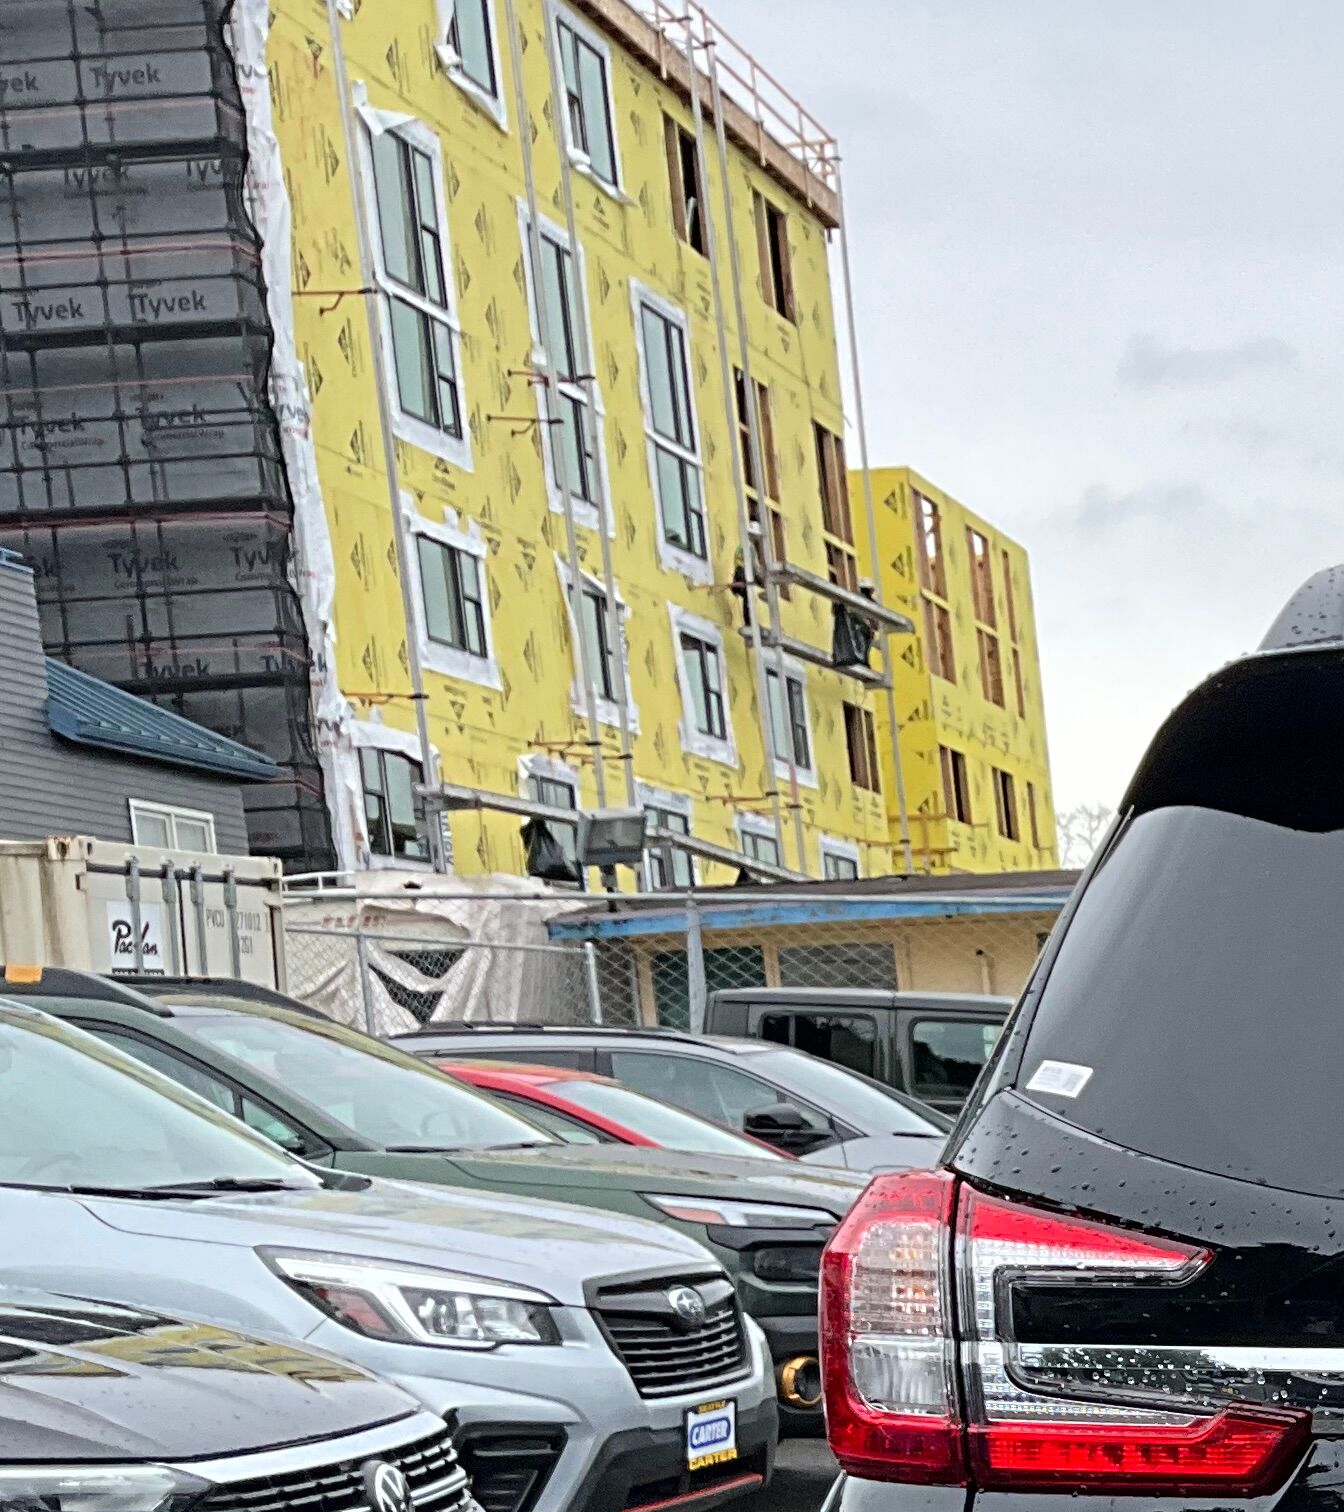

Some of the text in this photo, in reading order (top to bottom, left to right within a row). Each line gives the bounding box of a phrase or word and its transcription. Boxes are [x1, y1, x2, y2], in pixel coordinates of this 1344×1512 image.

[89, 63, 161, 93] Tyvek
[11, 298, 84, 327] Tyvek
[135, 289, 208, 319] Tyvek
[688, 1449, 737, 1471] CARTER
